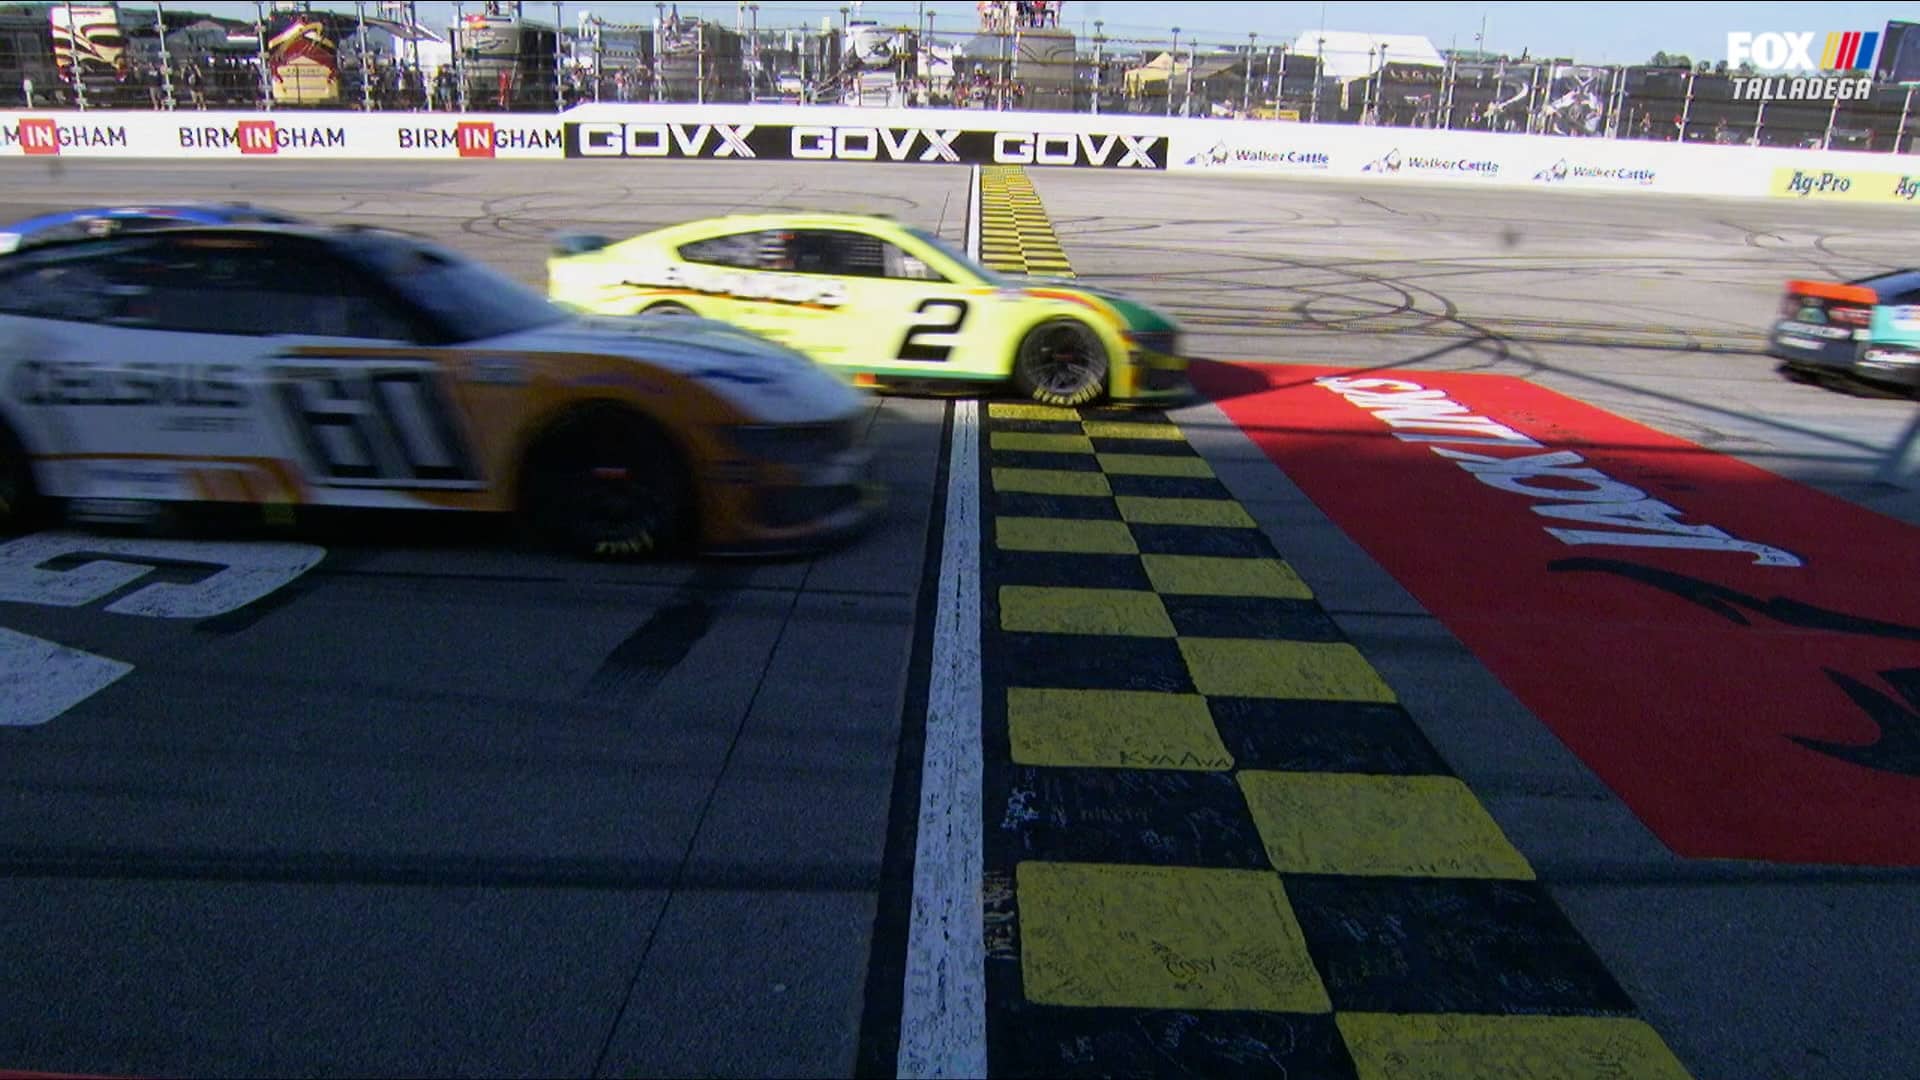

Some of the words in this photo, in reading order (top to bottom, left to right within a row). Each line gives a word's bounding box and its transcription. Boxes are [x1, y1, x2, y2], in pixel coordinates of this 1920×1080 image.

[179, 126, 346, 149] BIRMINGHAM
[398, 127, 563, 150] BIRMINGHAM
[578, 122, 755, 157] GOVX
[790, 126, 962, 161] GOVX
[993, 131, 1158, 168] GOVX
[1236, 149, 1285, 162] Walker
[1287, 150, 1329, 165] Cattle
[895, 298, 969, 362] 2
[273, 366, 475, 481] 60
[1430, 446, 1805, 568] JACK
